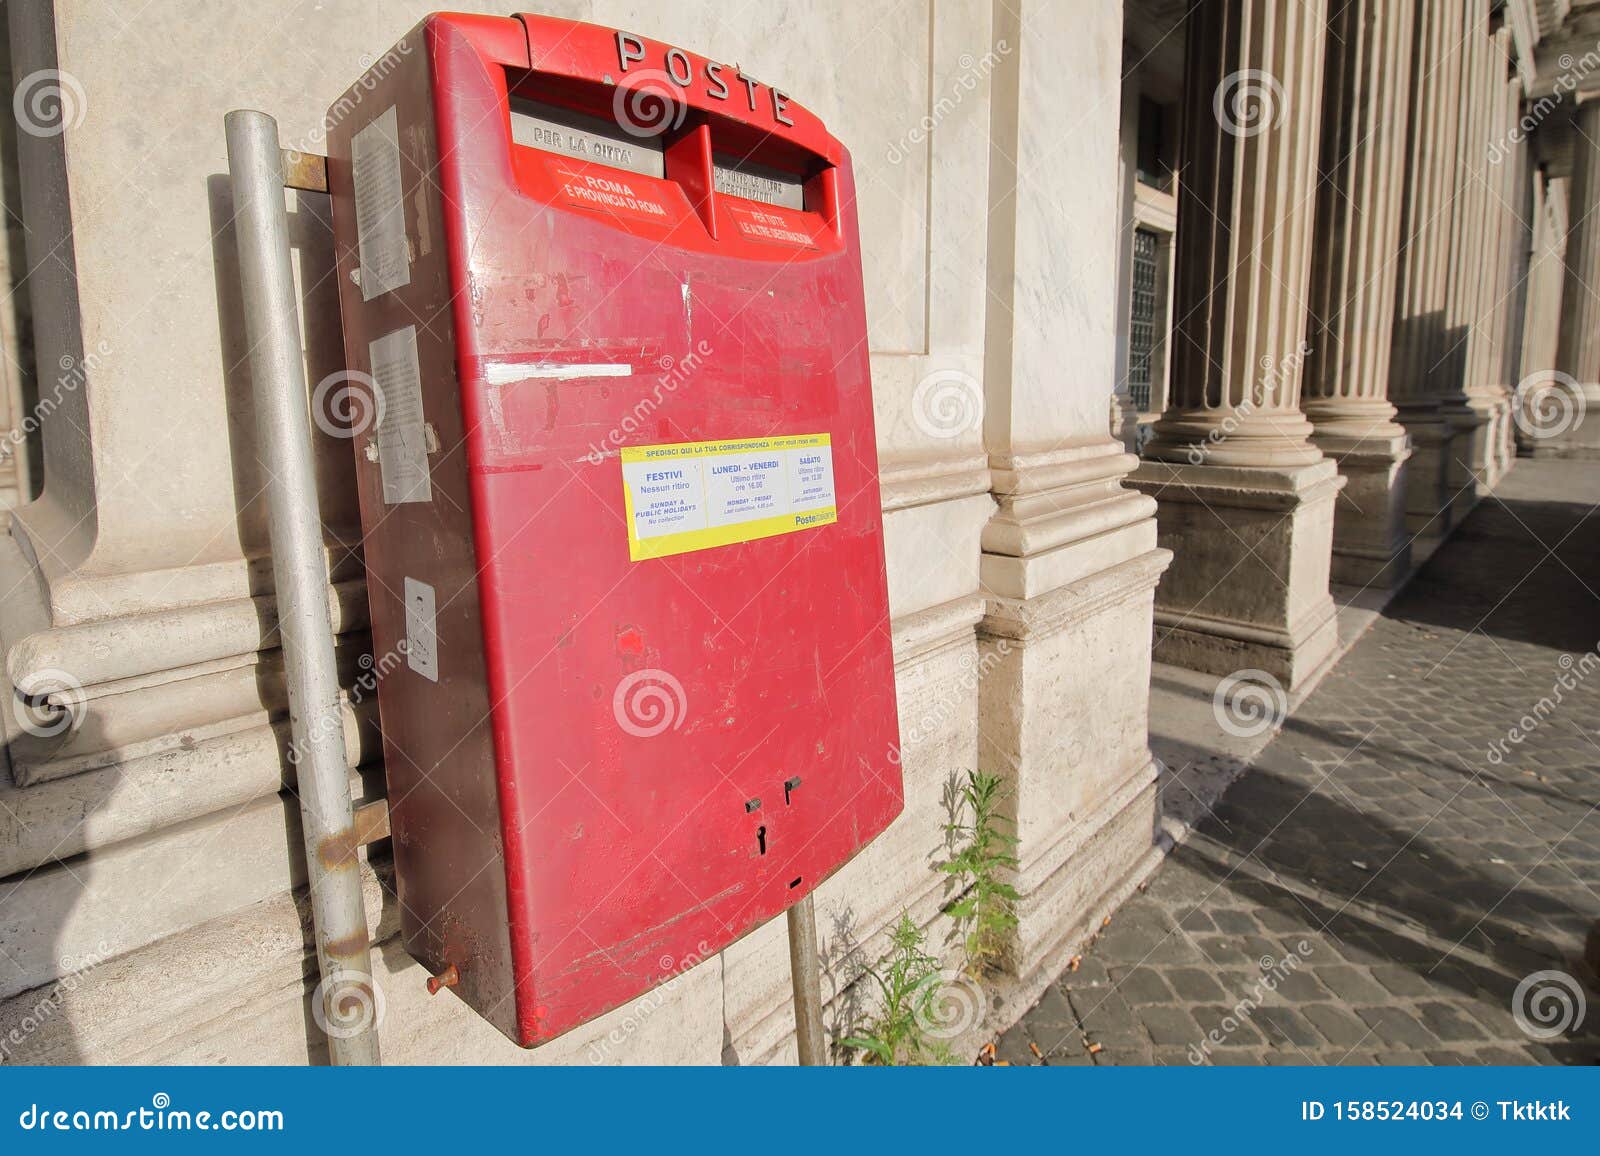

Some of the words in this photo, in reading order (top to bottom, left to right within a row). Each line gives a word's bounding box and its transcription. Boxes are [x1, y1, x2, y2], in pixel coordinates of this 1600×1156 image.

[615, 31, 794, 127] POSTE
[534, 127, 562, 148] PER
[569, 136, 587, 153] LA
[585, 176, 635, 197] ROMA
[564, 184, 575, 197] E
[575, 187, 627, 209] PROVINCIA
[627, 198, 639, 211] DI
[638, 200, 667, 216] ROMA
[646, 448, 679, 458] SPEDISCI
[680, 447, 693, 455] QUI
[799, 456, 821, 465] SABATO
[712, 464, 741, 475] LUNEDI
[748, 461, 779, 471] VENERDI
[646, 470, 683, 482] FESTIVI
[640, 485, 671, 494] Nessun
[672, 482, 690, 491] ritiro
[650, 500, 677, 510] SUNDAY
[727, 498, 749, 507] MONDAY
[635, 509, 661, 519] PUBLIC
[663, 504, 697, 515] HOLIDAYS
